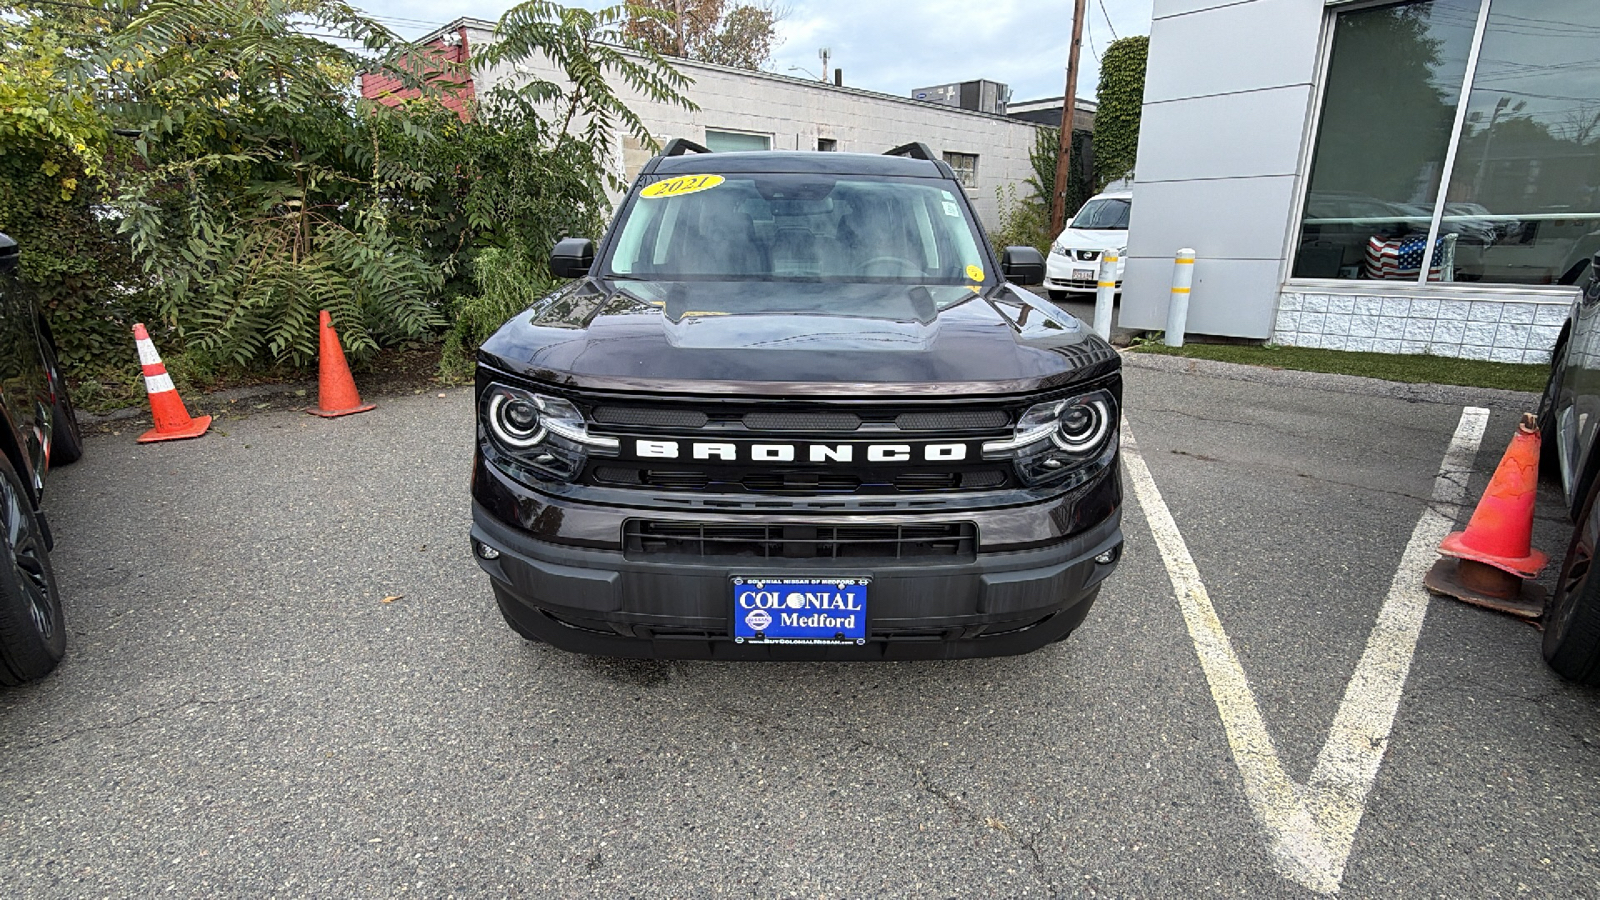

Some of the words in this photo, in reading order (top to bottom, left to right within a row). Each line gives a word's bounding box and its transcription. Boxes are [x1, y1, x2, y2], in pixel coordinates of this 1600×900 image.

[653, 176, 710, 196] 2021
[636, 439, 967, 462] BRONCO
[740, 591, 861, 610] COLONIAL
[780, 613, 855, 628] Medford
